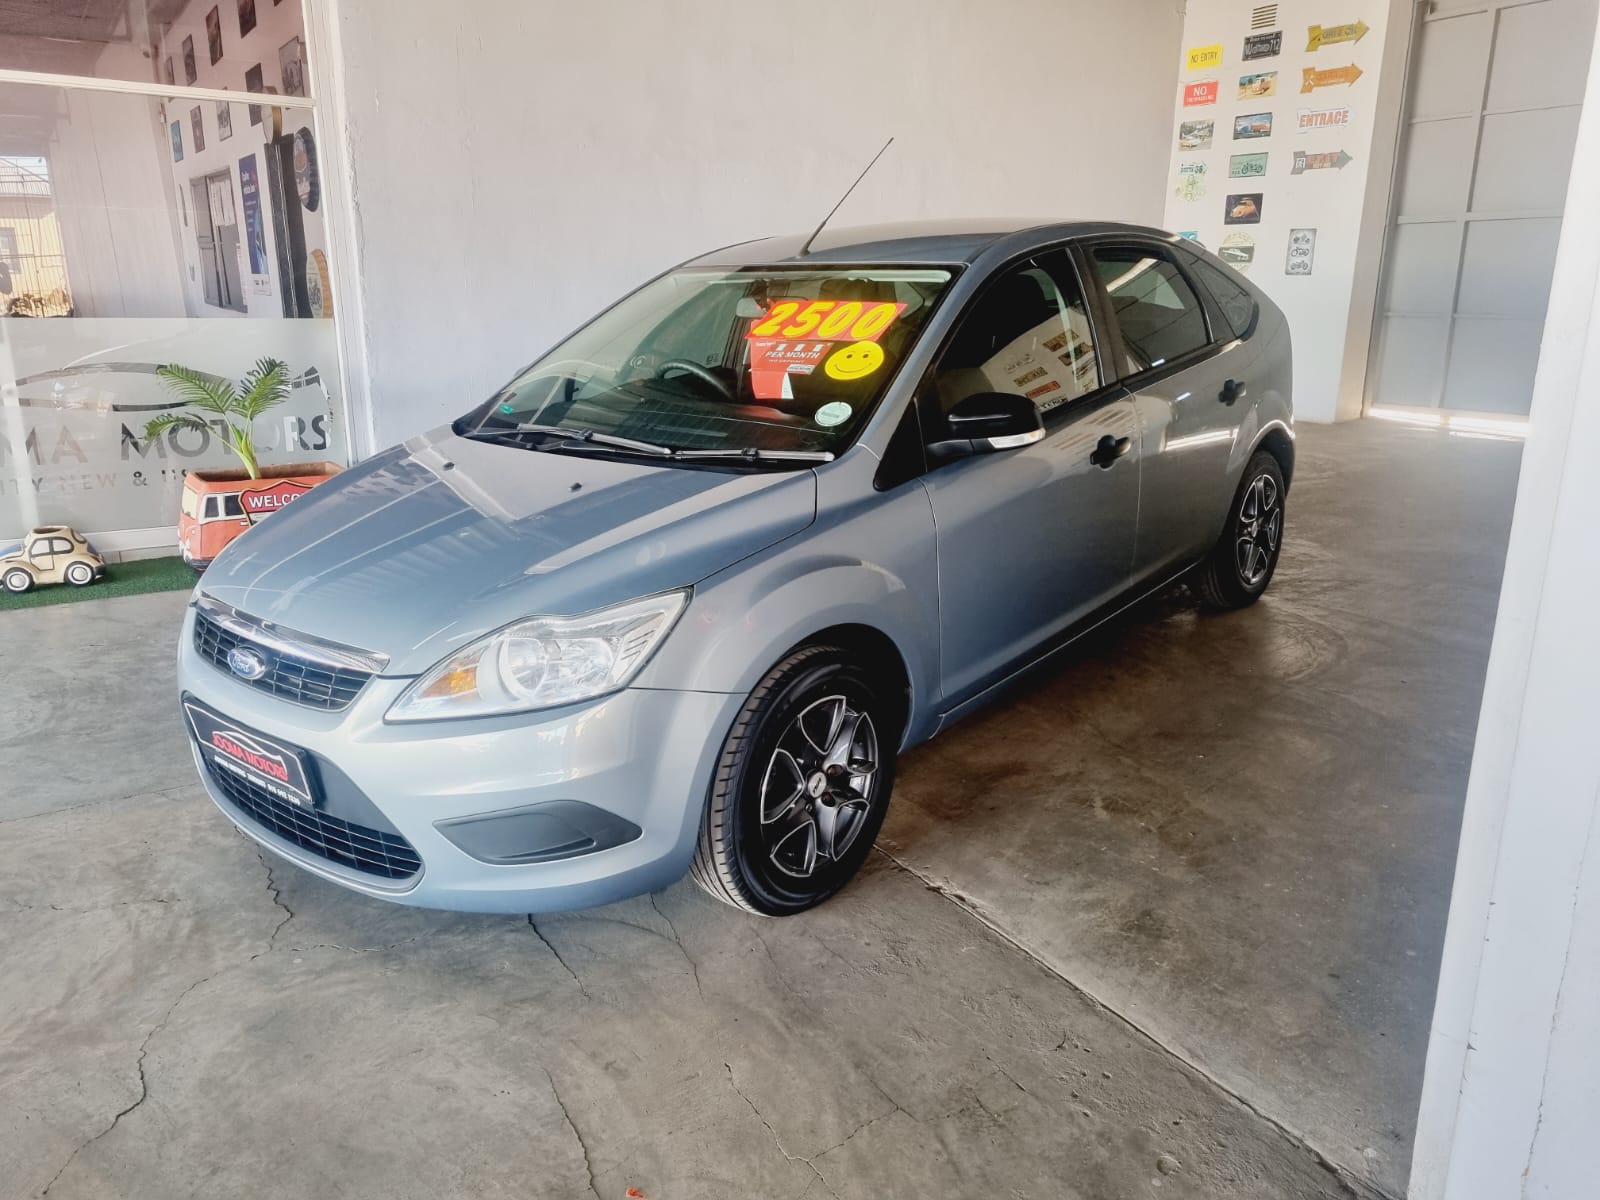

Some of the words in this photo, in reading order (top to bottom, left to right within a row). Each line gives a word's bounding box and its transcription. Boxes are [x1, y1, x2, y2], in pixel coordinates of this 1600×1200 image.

[1190, 54, 1199, 64] NO
[1200, 51, 1218, 62] ENTRY
[1193, 86, 1207, 97] NO
[1299, 110, 1349, 128] ENTRACE
[751, 301, 898, 340] 2500
[765, 351, 784, 359] PER
[785, 351, 821, 360] MONTH
[132, 471, 149, 487] &
[231, 652, 252, 674] Ford
